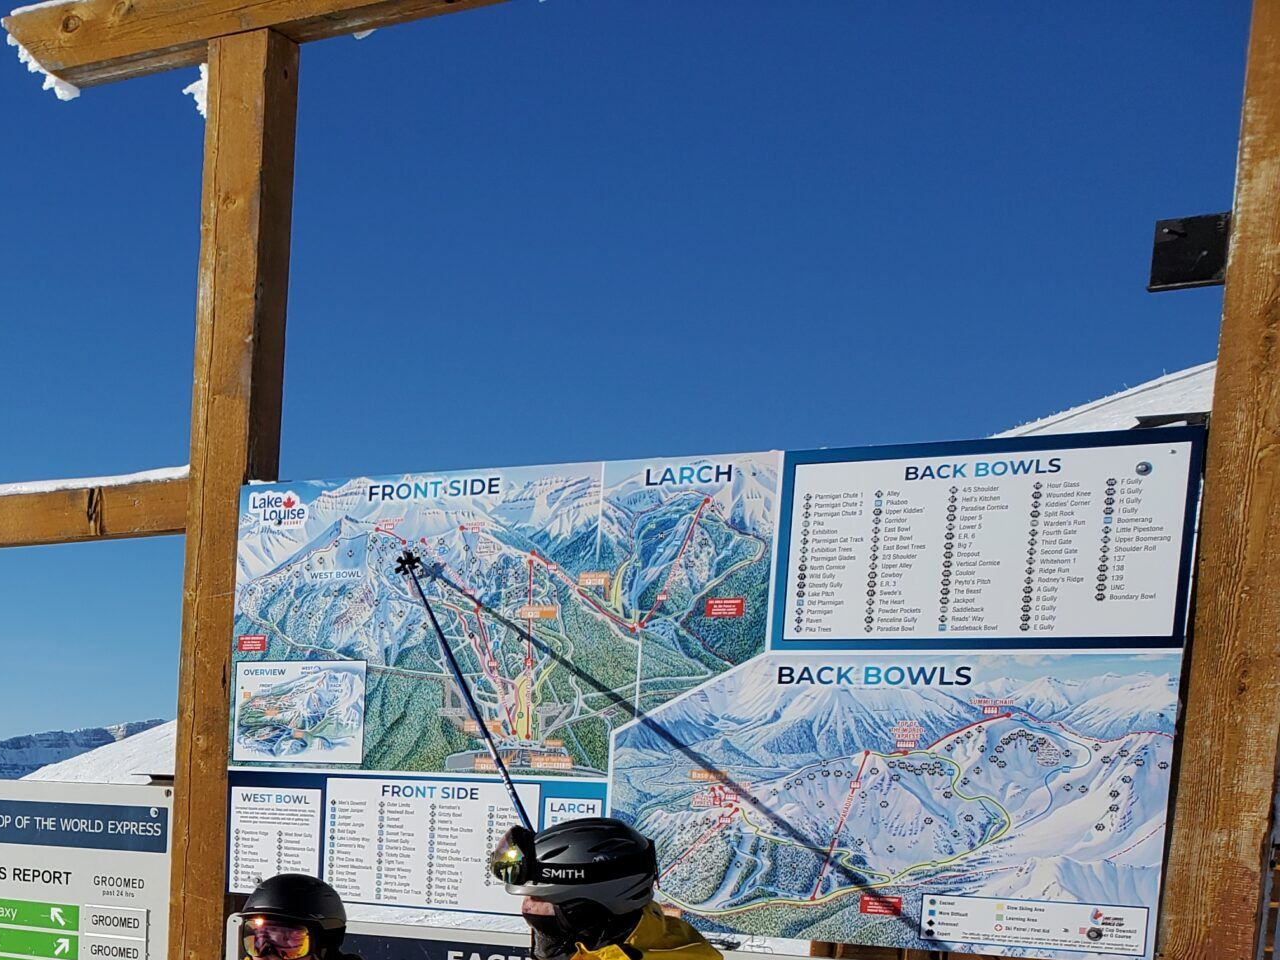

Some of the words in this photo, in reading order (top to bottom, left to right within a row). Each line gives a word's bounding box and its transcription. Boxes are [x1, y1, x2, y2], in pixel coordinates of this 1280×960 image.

[646, 464, 732, 486] LARCH
[905, 463, 967, 481] BACK
[974, 458, 1061, 477] BOWLS
[368, 481, 442, 502] FRONT
[449, 477, 500, 496] SIDE
[252, 496, 283, 509] Lake
[263, 508, 305, 521] Louise
[243, 668, 286, 676] OVERVIEW
[777, 665, 854, 685] BACK
[862, 665, 972, 687] BOWLS
[241, 792, 272, 804] WEST
[275, 794, 310, 805] BOWL
[381, 784, 437, 799] FRONT
[440, 786, 479, 800] SIDE
[550, 802, 595, 815] LARCH
[15, 816, 30, 829] OF
[35, 817, 56, 831] THE
[60, 819, 104, 833] WORLD
[107, 821, 162, 837] EXPRESS
[12, 867, 72, 885] REPORT
[542, 868, 585, 879] SMITH
[93, 875, 145, 890] GROOMED
[102, 889, 115, 898] past
[124, 890, 135, 898] hrs
[91, 915, 140, 929] GROOMED
[90, 945, 139, 959] GROOMED
